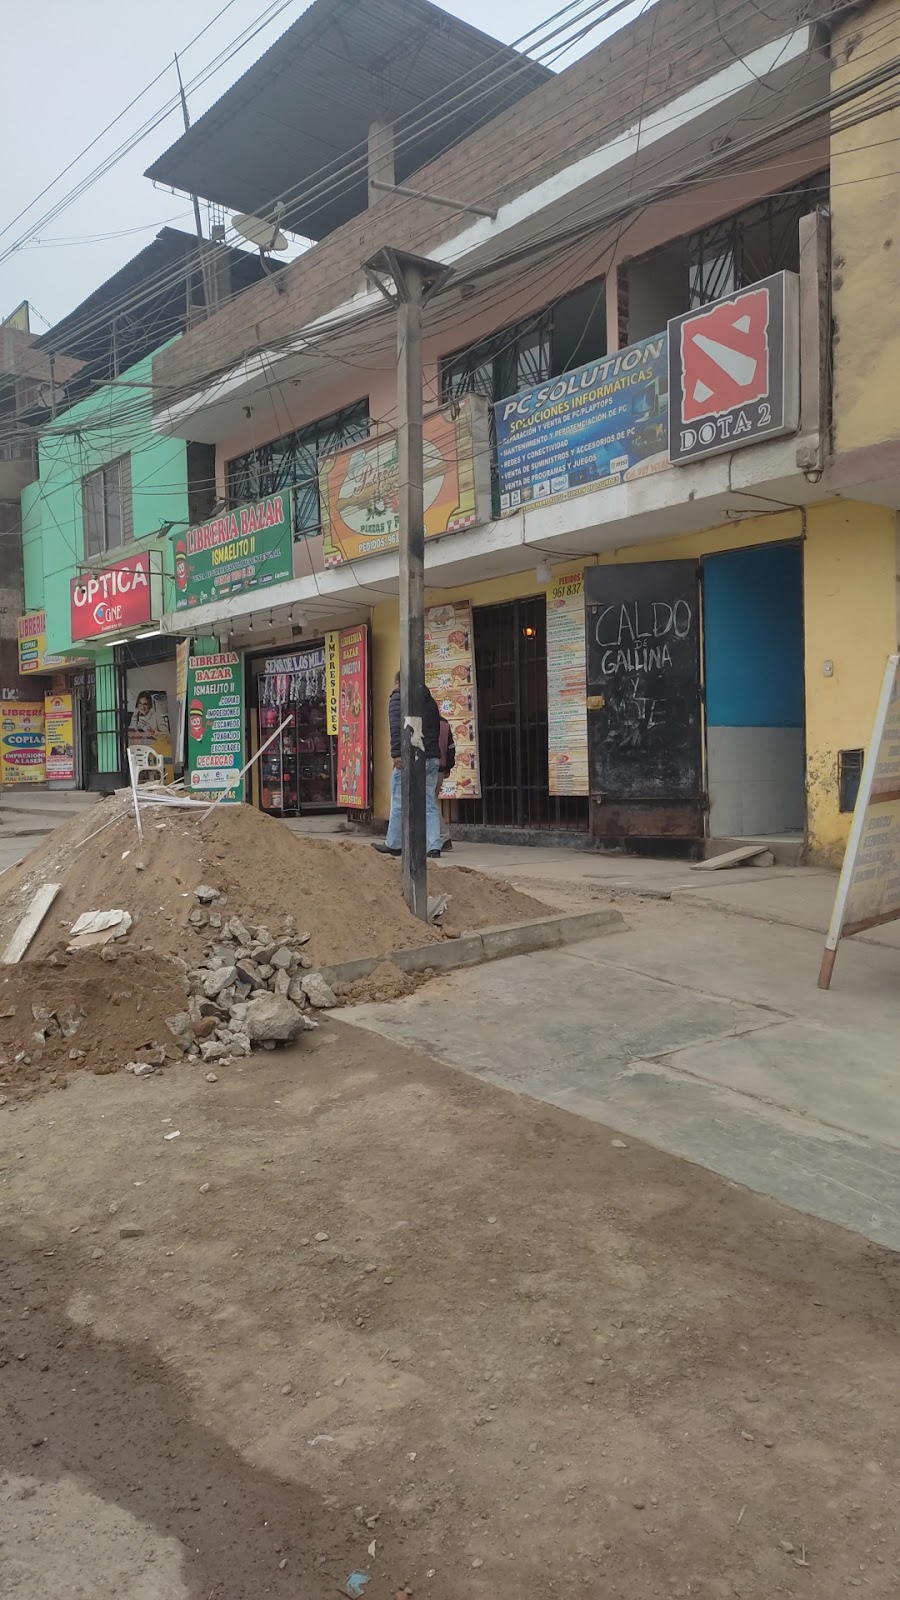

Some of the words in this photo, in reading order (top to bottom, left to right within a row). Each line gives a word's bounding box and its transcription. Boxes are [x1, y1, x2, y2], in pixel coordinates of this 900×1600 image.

[503, 394, 533, 421] PC
[535, 338, 665, 408] SOLUTION
[510, 400, 570, 433] SOLUCIONES
[571, 366, 653, 409] INFORMÁTICAS
[503, 435, 548, 456] MANTENIMIENTO
[608, 409, 617, 418] DE
[618, 404, 627, 415] PC
[543, 417, 562, 430] VENTA
[562, 413, 571, 422] DE
[680, 411, 752, 452] DOTA
[757, 403, 771, 426] 2
[503, 457, 521, 468] REDES
[521, 454, 527, 462] Y
[526, 439, 569, 459] CONECTIVIDAD
[504, 468, 521, 480] VENTA
[522, 464, 531, 473] DE
[530, 448, 570, 470] SUMINISTROS
[570, 448, 575, 456] Y
[576, 433, 615, 455] ACCESORIOS
[616, 430, 626, 440] DE
[626, 427, 636, 437] PC
[504, 480, 522, 492] VENTA
[522, 476, 531, 485] DE
[531, 464, 567, 482] PROGRAMAS
[567, 462, 573, 471] Y
[573, 453, 598, 468] JUEGOS
[186, 513, 239, 556] LIBRERIA
[240, 496, 284, 536] BAZAR
[360, 523, 385, 533] PIZZAS
[212, 538, 249, 566] ISMAELITO
[250, 536, 255, 554] II
[358, 535, 387, 553] PEDIDOS:
[552, 586, 565, 598] 961
[567, 583, 582, 595] 837
[558, 573, 581, 586] PEDIDOS
[595, 600, 692, 646] CALDO
[189, 651, 239, 668] LIBRERIA
[601, 644, 673, 675] GALLINA
[633, 640, 648, 650] DE
[195, 667, 232, 682] BAZAR
[328, 634, 338, 732] IMPRESIONES
[193, 684, 229, 697] ISMAELITO
[229, 683, 235, 693] II
[197, 754, 234, 768] RECARGAS
[211, 743, 240, 753] ESCOLARES
